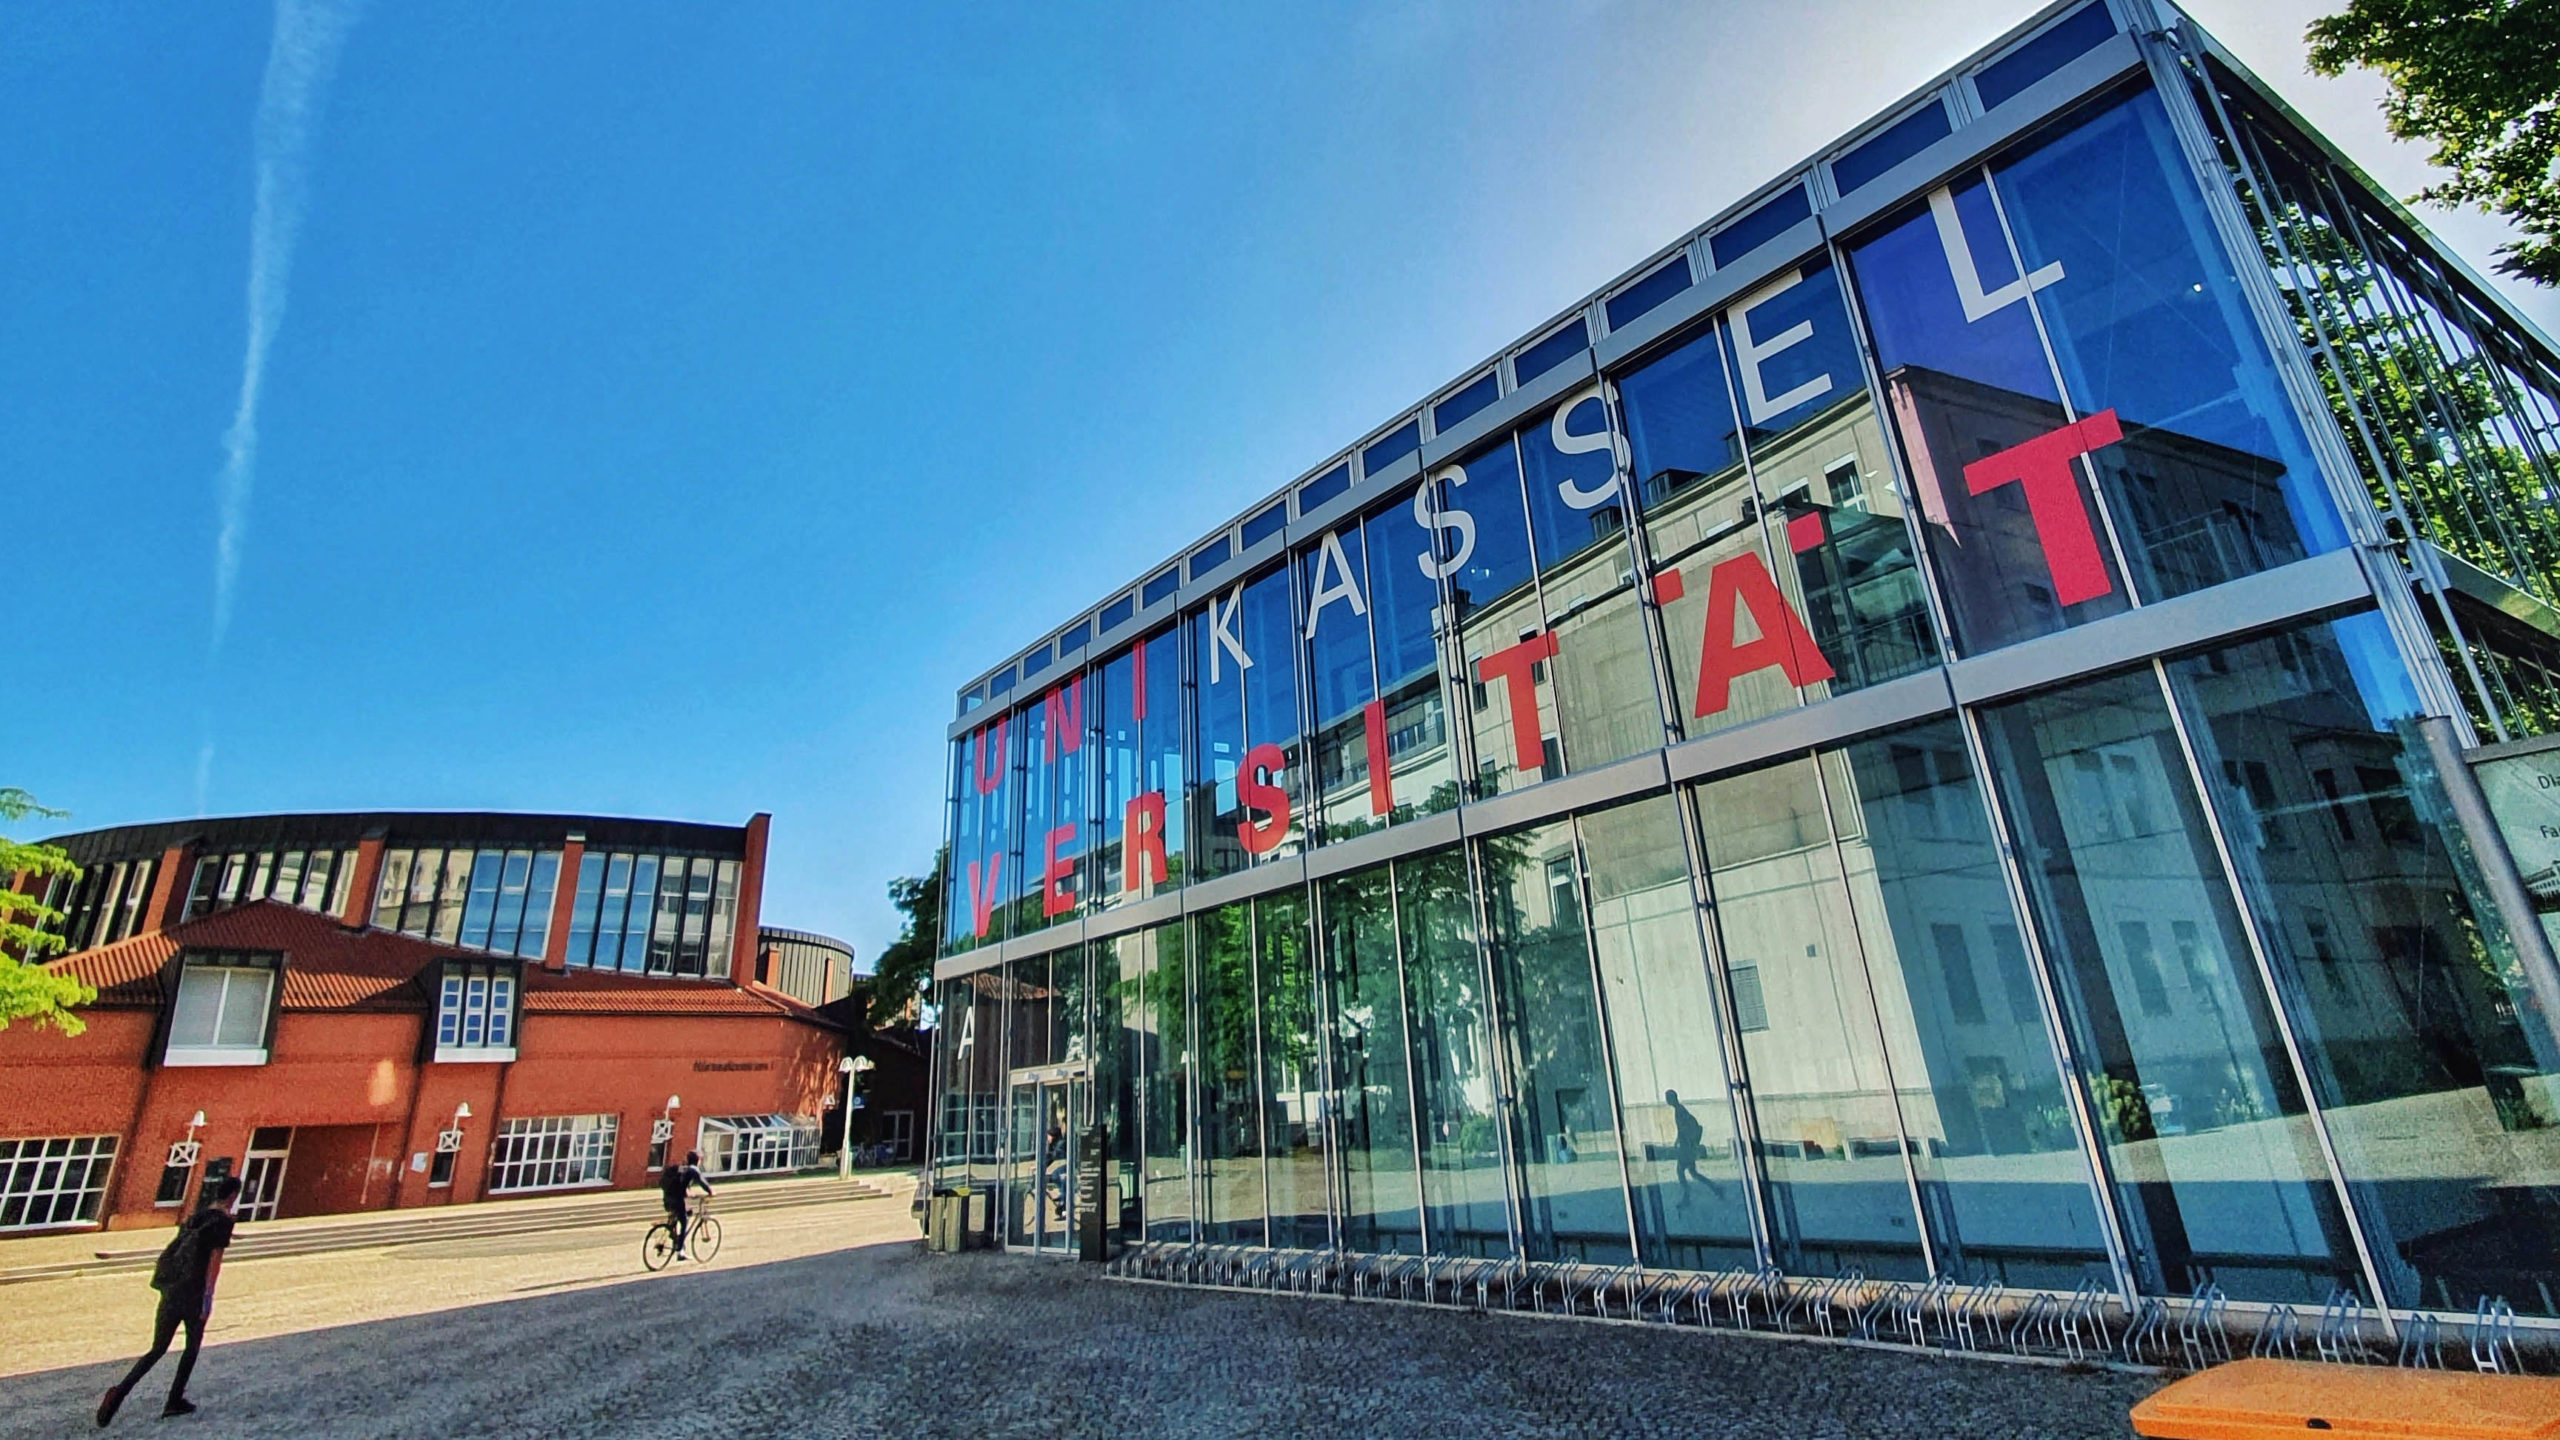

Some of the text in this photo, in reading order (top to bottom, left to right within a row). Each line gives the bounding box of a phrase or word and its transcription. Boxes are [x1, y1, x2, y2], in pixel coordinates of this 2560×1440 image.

[967, 407, 2125, 939] VERSITÄT
[973, 185, 2066, 796] UNI KASSEL
